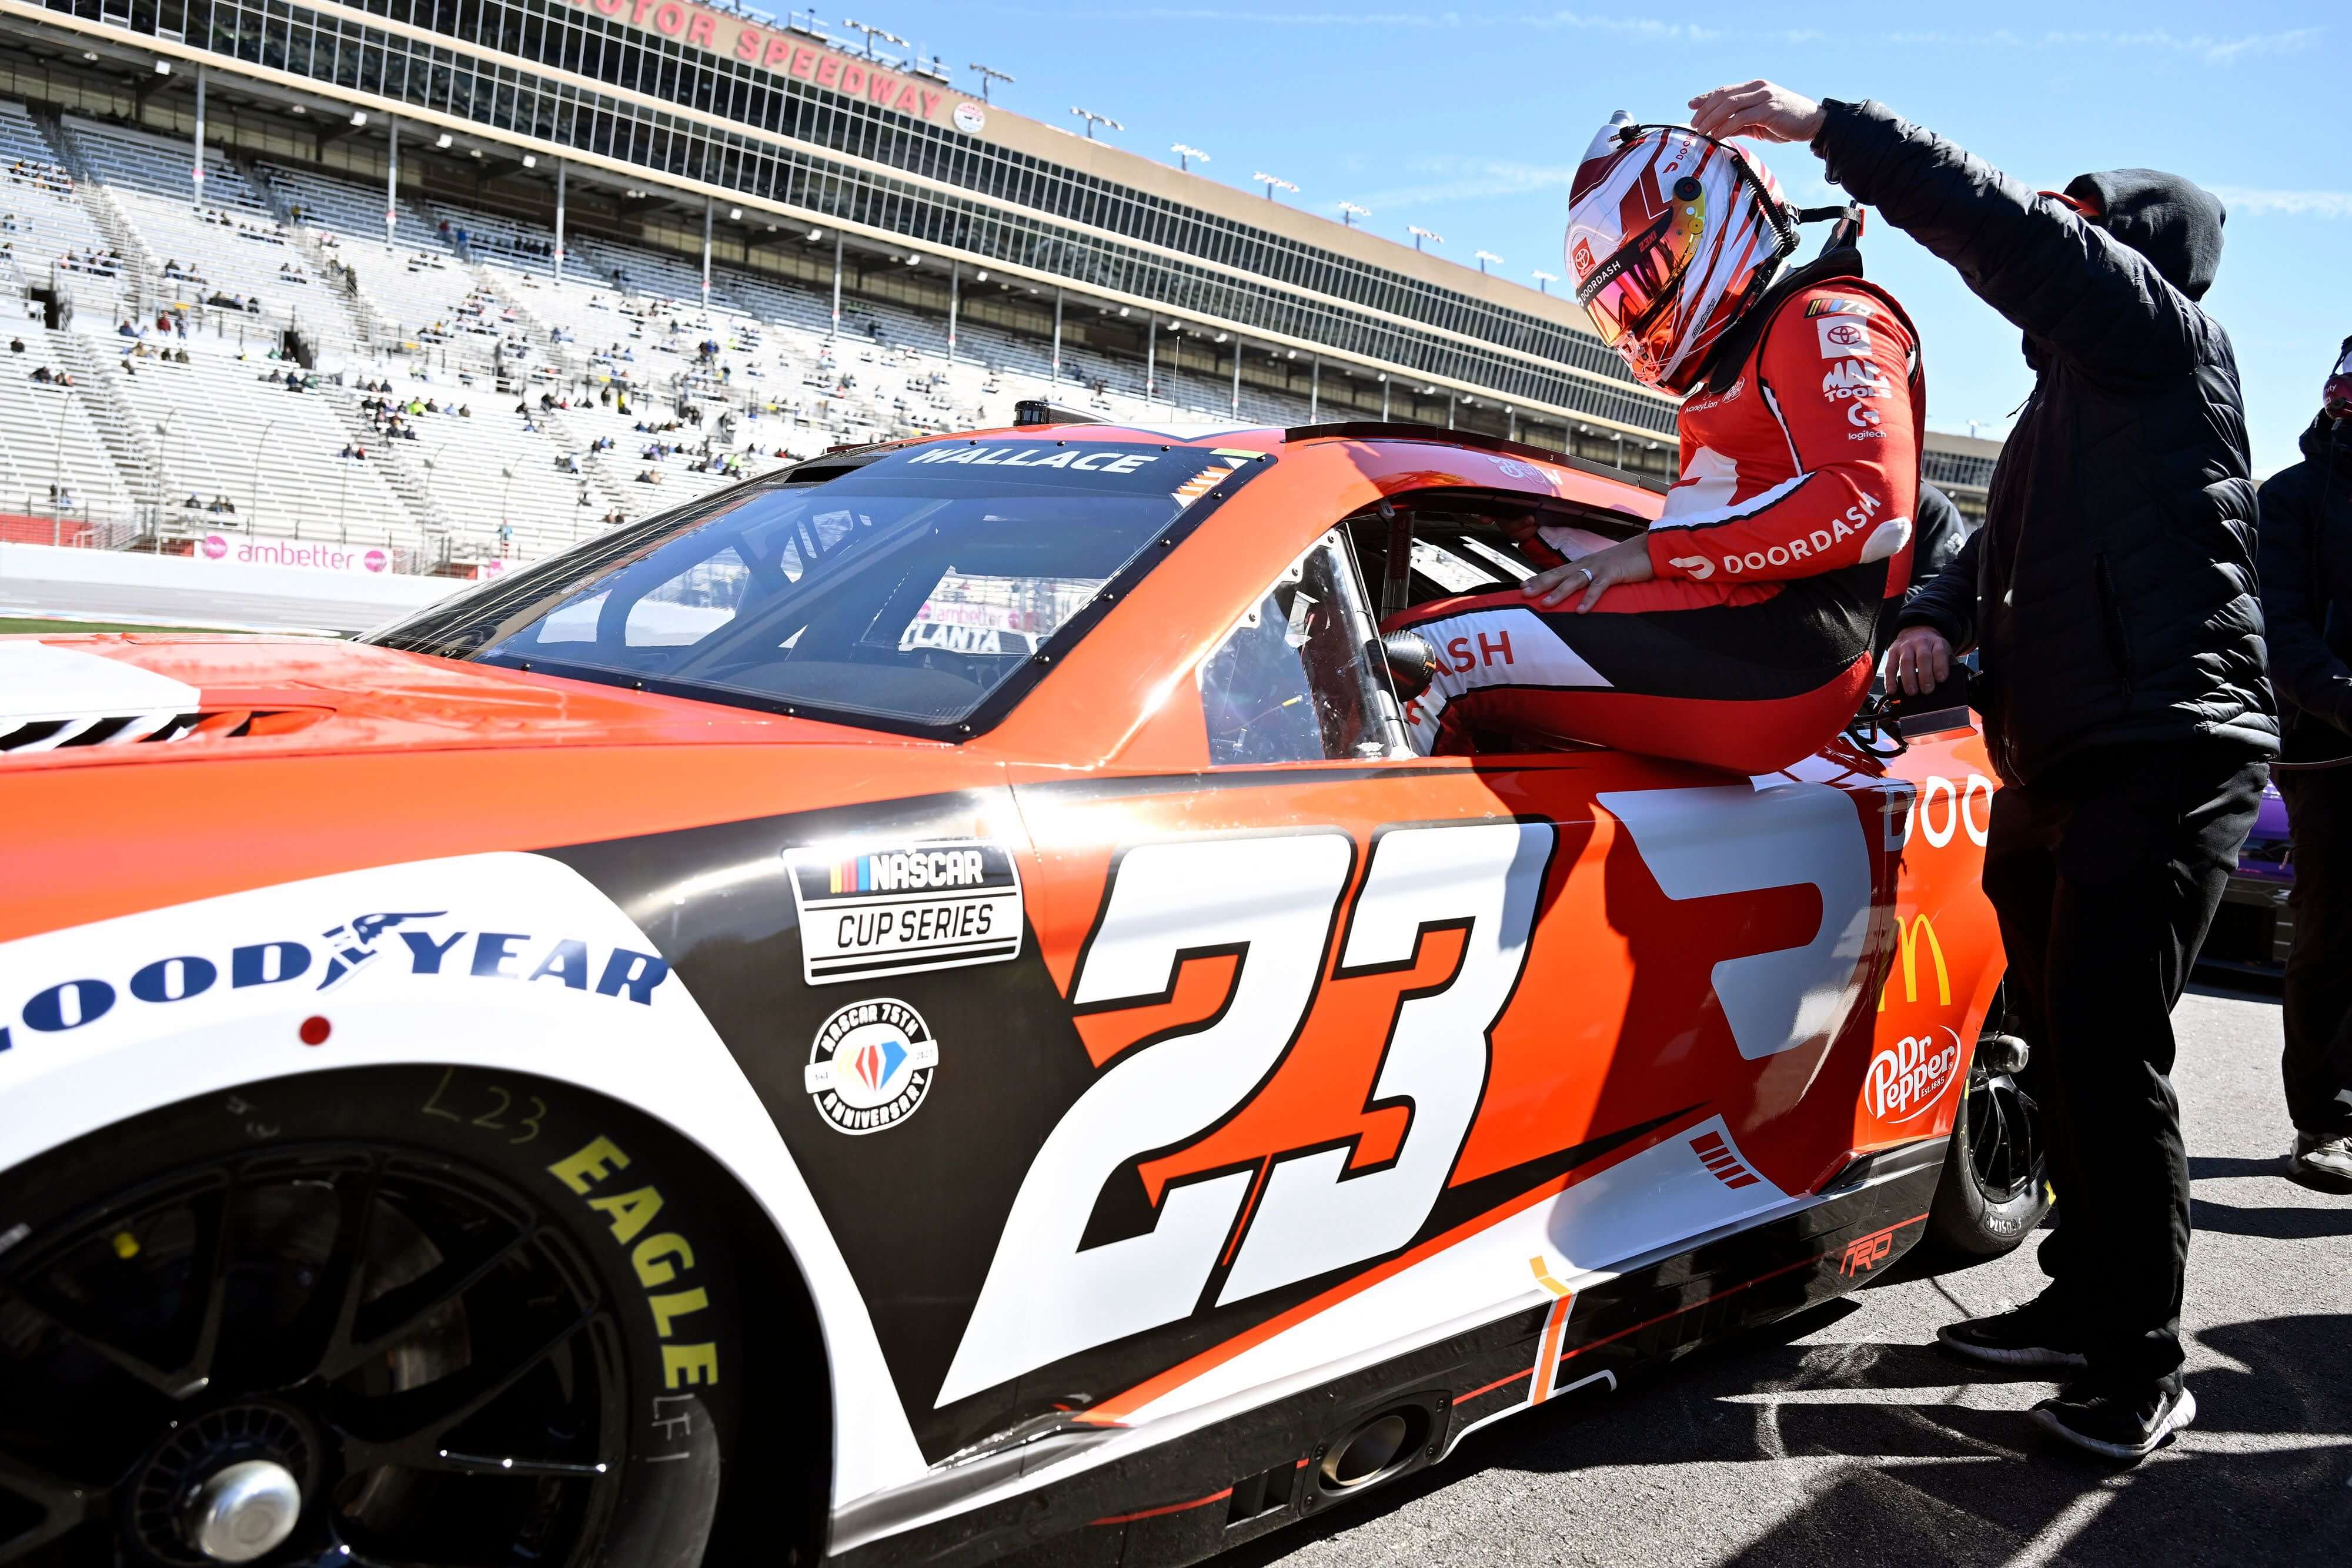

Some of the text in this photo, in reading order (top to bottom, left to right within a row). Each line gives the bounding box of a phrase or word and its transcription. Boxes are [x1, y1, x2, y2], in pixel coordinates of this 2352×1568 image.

[562, 0, 716, 47] TOR
[736, 29, 941, 119] SPEEDWAY
[1580, 260, 1622, 302] DOORDASH
[1825, 387, 1892, 403] TOOLS
[1848, 429, 1887, 441] logitech
[907, 447, 1160, 474] WALLACE
[1723, 492, 1882, 574] DOORDASH
[237, 541, 355, 570] ambetter
[869, 850, 984, 891] NASCAR
[837, 904, 994, 949] CUP SERIES
[821, 1003, 919, 1054] NASCAR 75TH
[1897, 1035, 1932, 1078] Dr
[823, 1071, 926, 1130] ANNIVERSARY
[1865, 1045, 1955, 1120] Pepper
[1921, 1076, 1945, 1098] Est.1885
[933, 822, 1554, 1409] 23
[547, 1135, 719, 1389] EAGLE
